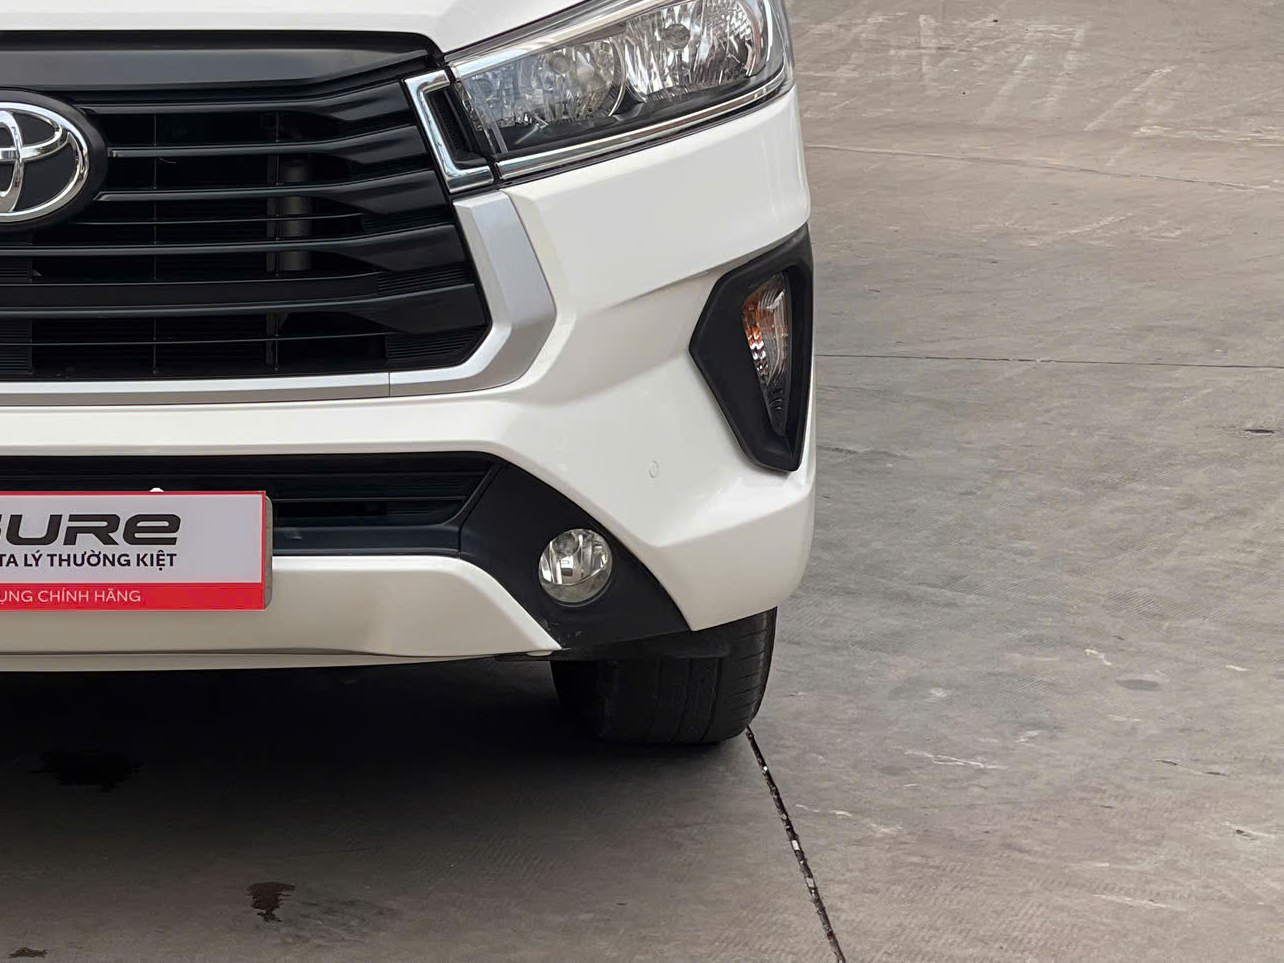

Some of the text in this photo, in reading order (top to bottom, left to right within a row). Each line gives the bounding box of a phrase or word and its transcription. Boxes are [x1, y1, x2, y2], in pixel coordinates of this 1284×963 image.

[23, 550, 44, 567] LÝ
[47, 549, 131, 568] THƯỜNG
[136, 549, 178, 571] KIỆT
[37, 587, 90, 603] CHÍNH
[94, 587, 141, 603] HÃNG
